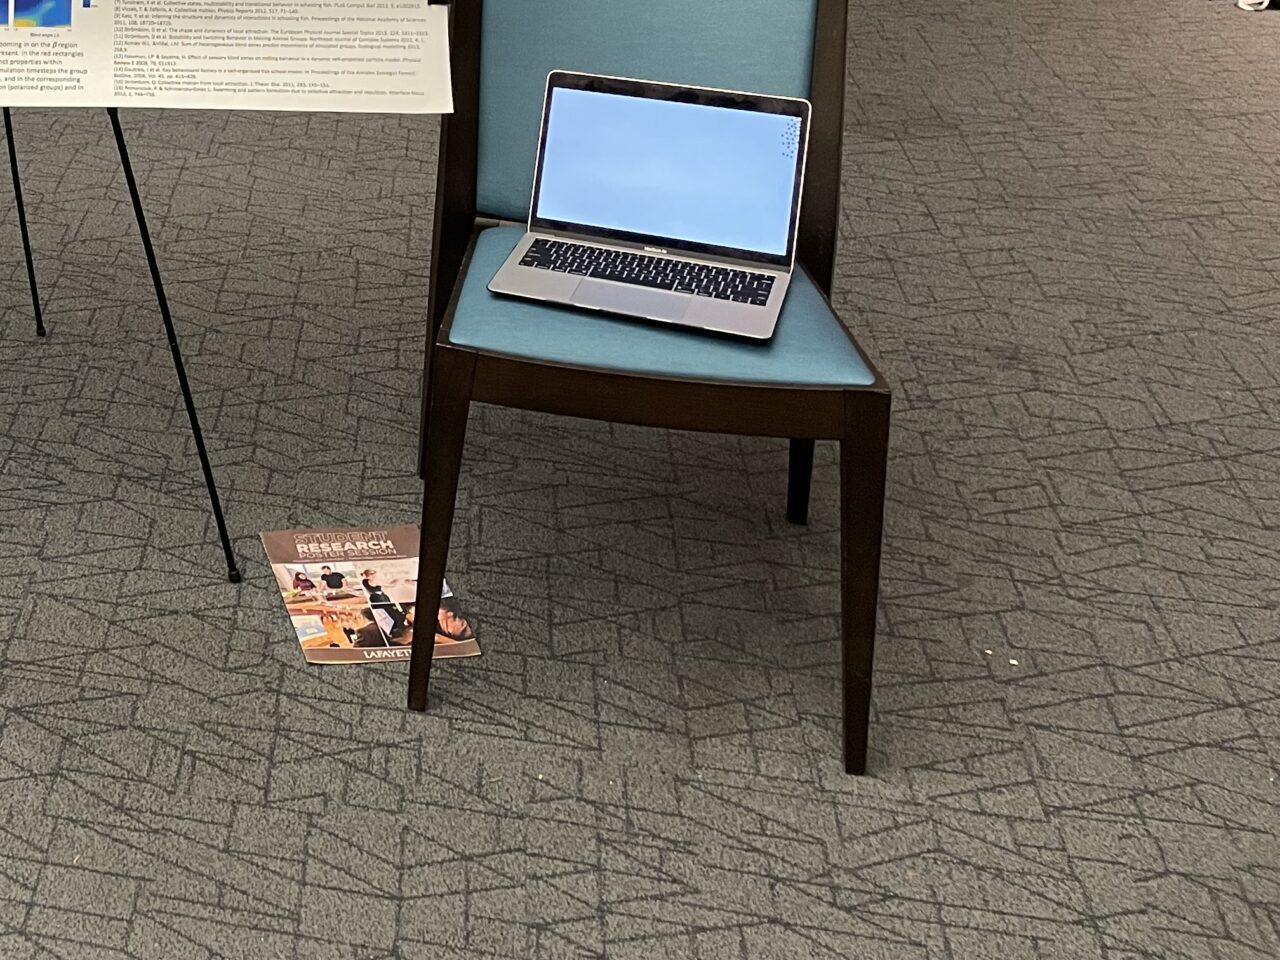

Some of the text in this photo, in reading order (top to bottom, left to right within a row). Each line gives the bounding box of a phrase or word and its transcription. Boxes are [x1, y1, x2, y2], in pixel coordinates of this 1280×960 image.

[294, 531, 387, 544] STUDENT
[296, 540, 394, 553] RESEARCH
[299, 550, 345, 559] POSTER
[347, 548, 397, 557] SESSION
[363, 649, 412, 659] LAFAYET
